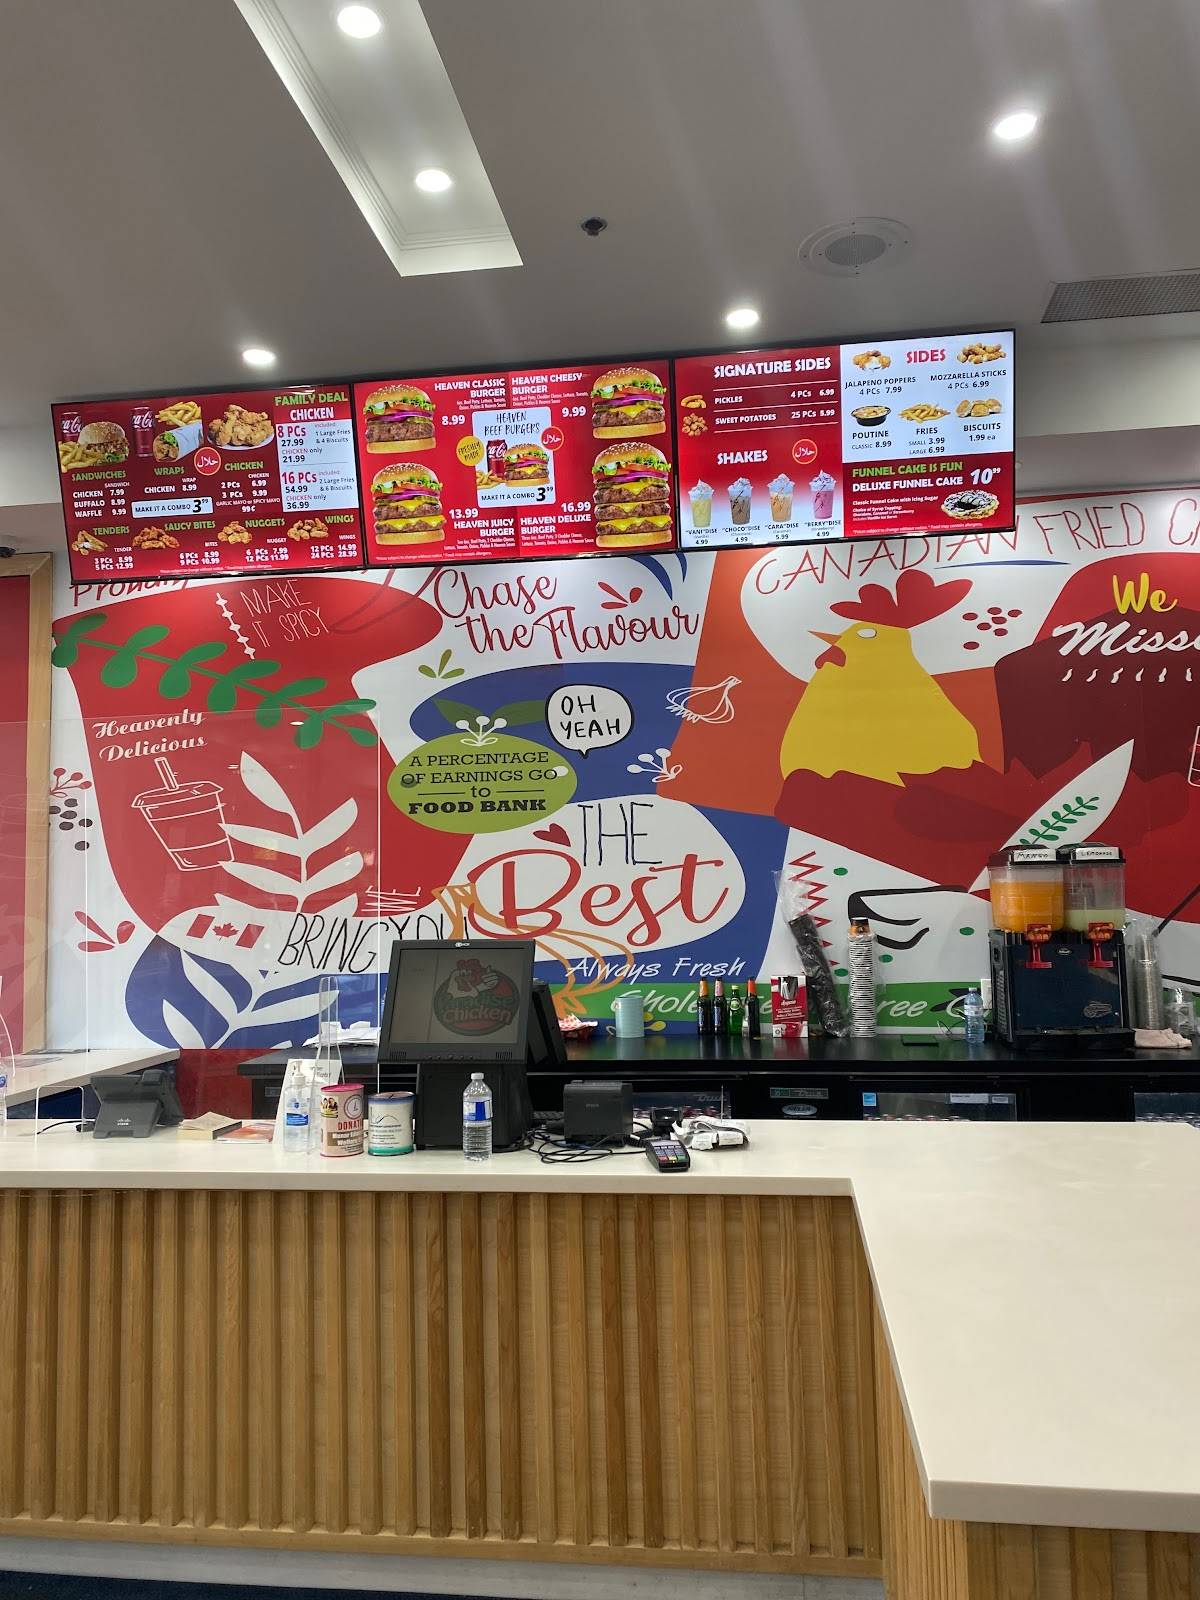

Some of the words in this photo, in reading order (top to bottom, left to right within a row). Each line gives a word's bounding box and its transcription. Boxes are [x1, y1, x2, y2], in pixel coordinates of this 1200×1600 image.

[906, 349, 946, 363] SIDES
[714, 360, 791, 378] SIGNATURE
[795, 357, 831, 371] SIDES
[512, 375, 548, 385] HEAVEN
[550, 373, 583, 382] CHEESY
[930, 372, 980, 381] MOZZARELLA
[435, 381, 470, 391] HEAVEN
[472, 378, 505, 388] CLASSIC
[512, 386, 547, 394] BURGER
[886, 386, 902, 394] 7.99
[274, 394, 315, 406] FAMILY
[318, 392, 348, 402] DEAL
[470, 388, 505, 398] BURGER
[715, 396, 742, 404] PICKLES
[290, 407, 334, 420] CHICKEN
[496, 411, 527, 424] HEAVEN
[562, 406, 586, 417] 9.99
[442, 415, 465, 425] 8.99
[715, 416, 738, 425] SWEET
[740, 414, 776, 422] POTATOES
[278, 425, 284, 438] 8
[288, 425, 306, 437] PCs
[484, 426, 501, 436] BEEF
[505, 423, 540, 435] BURGERS
[963, 423, 1000, 432] BISCUITS
[852, 431, 889, 439] POUTINE
[282, 455, 305, 463] 21.99
[717, 450, 768, 464] SHAKES
[154, 467, 184, 476] WRAPS
[224, 462, 263, 471] CHICKEN
[852, 467, 895, 478] FUNNEL
[897, 465, 926, 474] CAKE
[929, 463, 937, 472] IS
[940, 462, 963, 471] FUN
[72, 470, 126, 481] SANDWICHES
[282, 473, 294, 485] 16
[298, 471, 317, 483] PCs
[285, 485, 308, 494] 54.99
[852, 481, 891, 492] DELUXE
[893, 478, 933, 489] FUNNEL
[936, 476, 963, 486] CAKE
[74, 500, 105, 508] BUFFALO
[561, 502, 591, 512] 16.99
[325, 515, 354, 523] WINGS
[449, 509, 478, 518] 13.99
[521, 516, 556, 525] HEAVEN
[558, 514, 591, 523] DELUXE
[164, 522, 191, 531] SAUCY
[194, 521, 216, 529] BITES
[245, 519, 285, 528] NUGGETS
[454, 520, 489, 528] HEAVEN
[491, 519, 514, 527] JUICY
[521, 525, 555, 534] BURGER
[1032, 502, 1145, 555] FRIED
[93, 526, 129, 535] TENDERS
[480, 528, 514, 536] BURGER
[239, 580, 312, 618] MAKE
[433, 569, 557, 618] Chase
[1112, 572, 1178, 614] We
[252, 620, 271, 648] IT
[278, 607, 331, 643] SPICY
[455, 613, 534, 654] the
[533, 605, 700, 659] Flavour
[1052, 621, 1200, 656] Miss
[561, 694, 596, 715] OH
[92, 708, 207, 738] Heavenly
[560, 719, 621, 739] YEAH
[99, 735, 208, 762] Delicious
[409, 756, 422, 767] A
[427, 751, 549, 766] PERCENTAGE
[400, 773, 426, 784] OF
[431, 770, 523, 784] EARNINGS
[529, 768, 557, 780] GO
[470, 785, 491, 798] to
[408, 802, 473, 814] FOOD
[480, 800, 546, 812] BANK
[577, 802, 662, 866] THE
[467, 848, 729, 946] Best
[278, 913, 389, 973] BRING
[566, 957, 661, 985] Always
[672, 957, 746, 977] Fresh
[876, 1000, 927, 1017] ree
